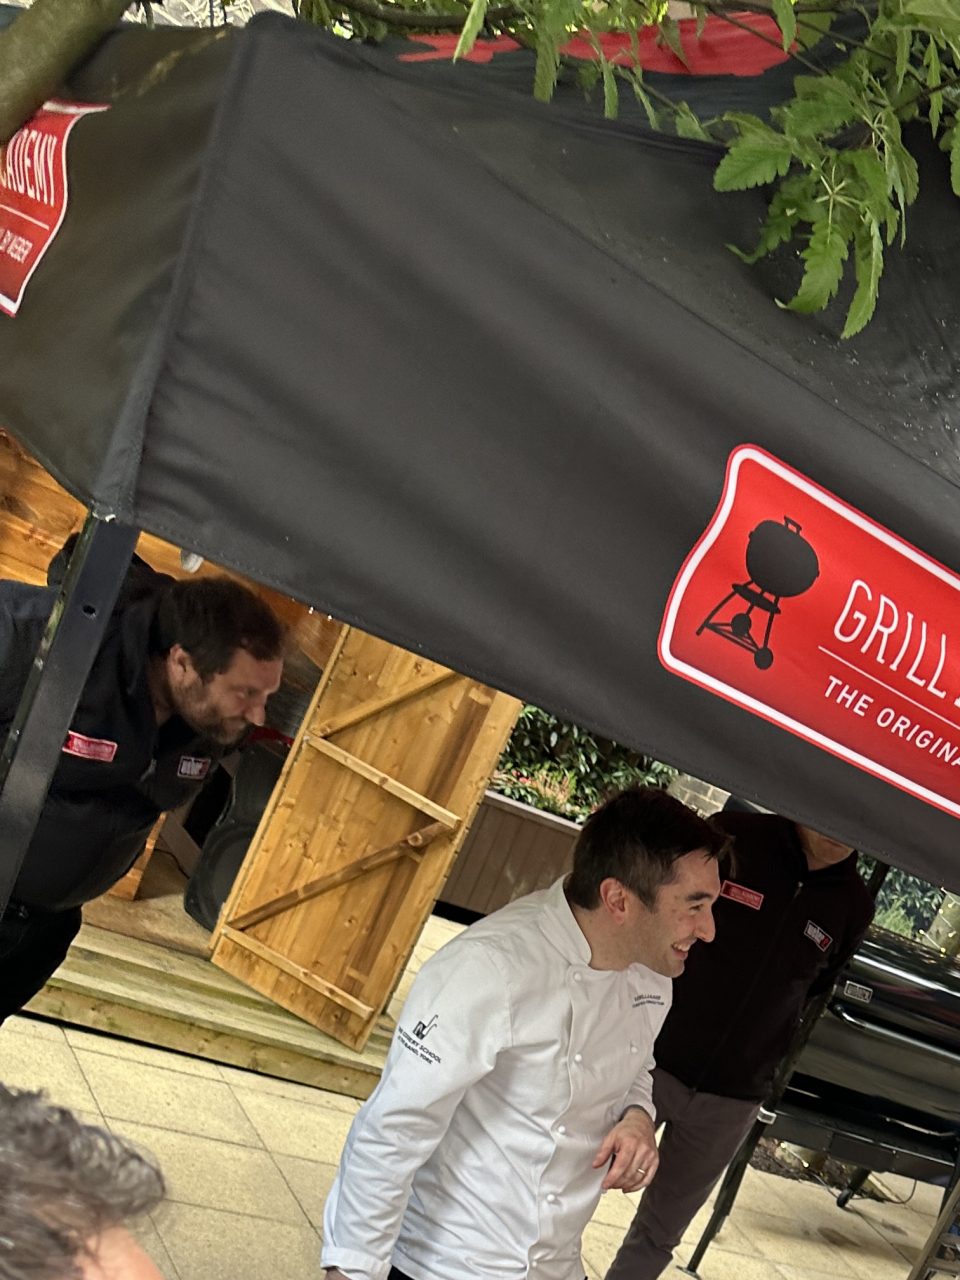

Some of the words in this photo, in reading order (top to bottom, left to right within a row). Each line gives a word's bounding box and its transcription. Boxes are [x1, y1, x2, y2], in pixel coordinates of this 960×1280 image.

[0, 127, 57, 208] ADEMY
[833, 578, 948, 700] GRILL
[822, 675, 874, 717] THE
